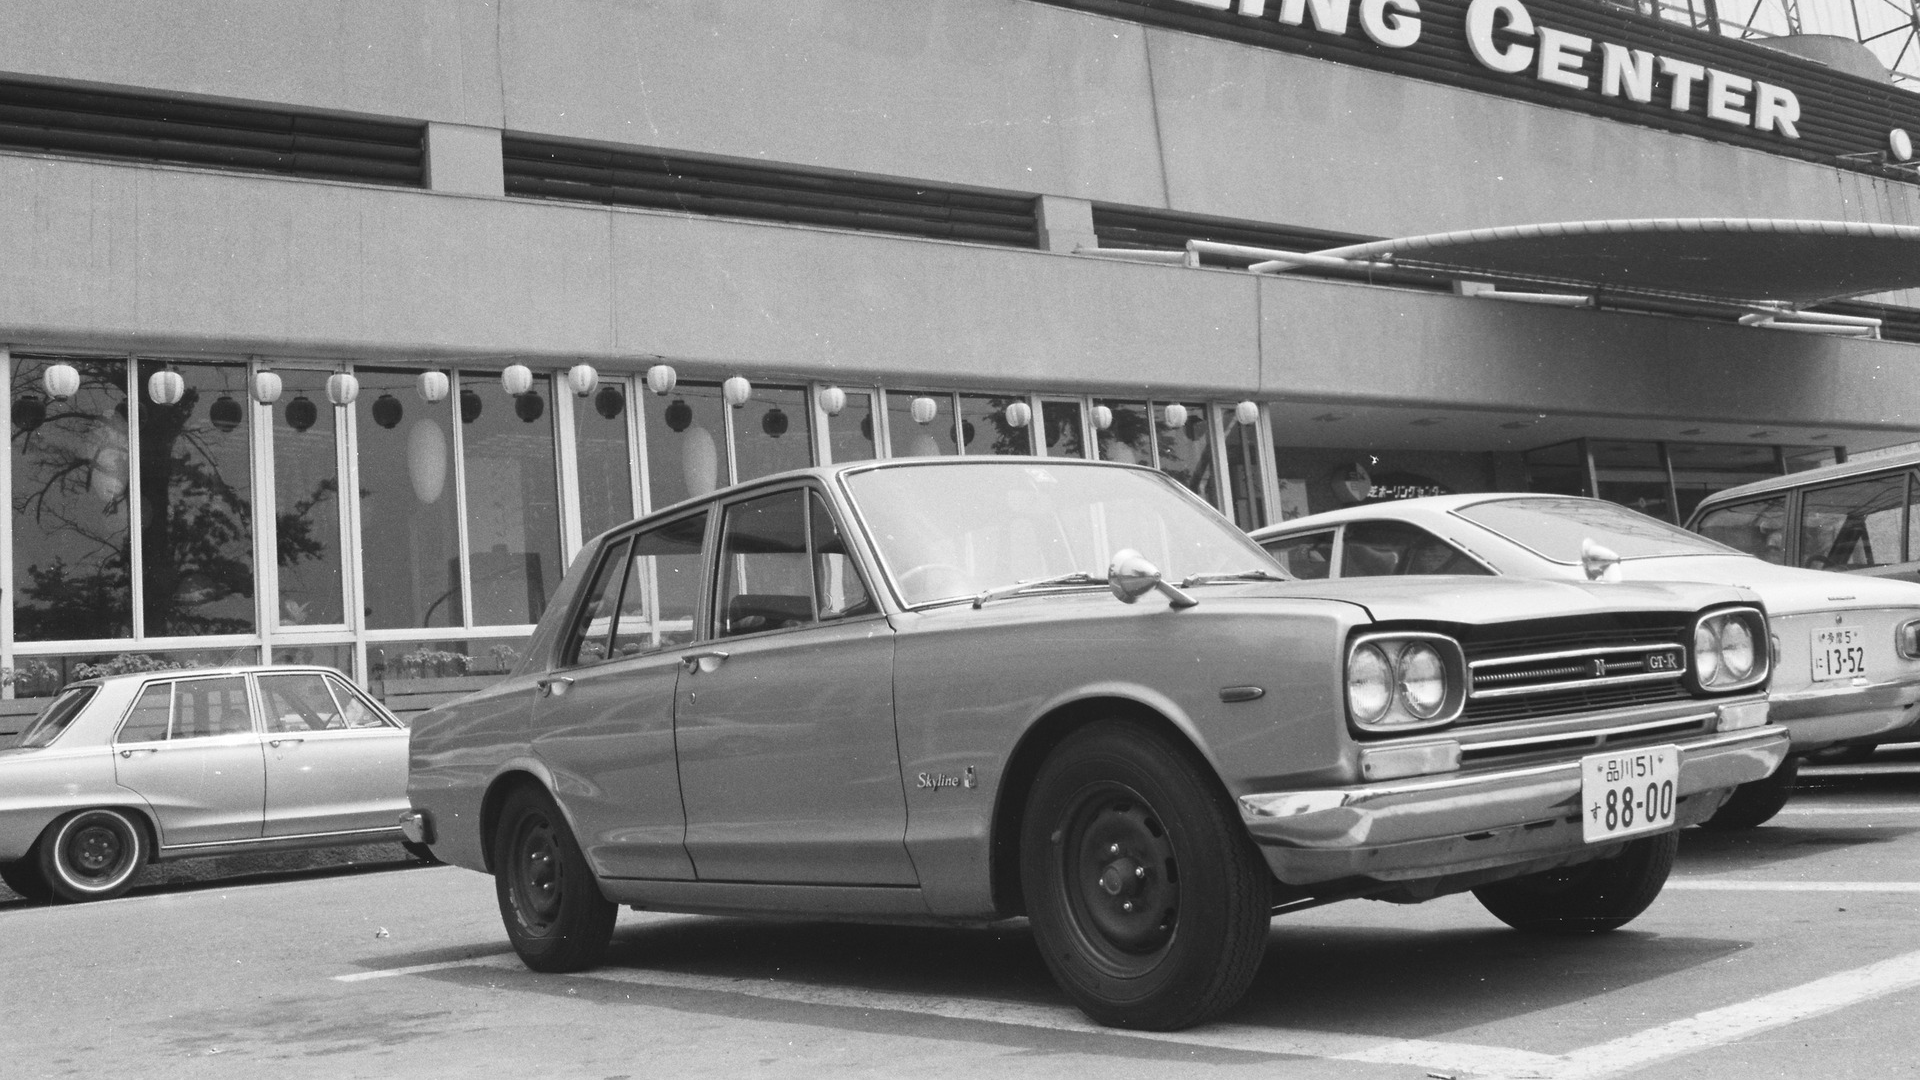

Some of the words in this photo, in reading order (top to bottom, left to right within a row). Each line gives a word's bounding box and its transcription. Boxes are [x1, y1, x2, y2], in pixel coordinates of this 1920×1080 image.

[1465, 0, 1800, 139] CENTER
[1649, 653, 1678, 669] GT-R
[917, 772, 960, 791] Skyline
[1605, 779, 1673, 831] 88-00
